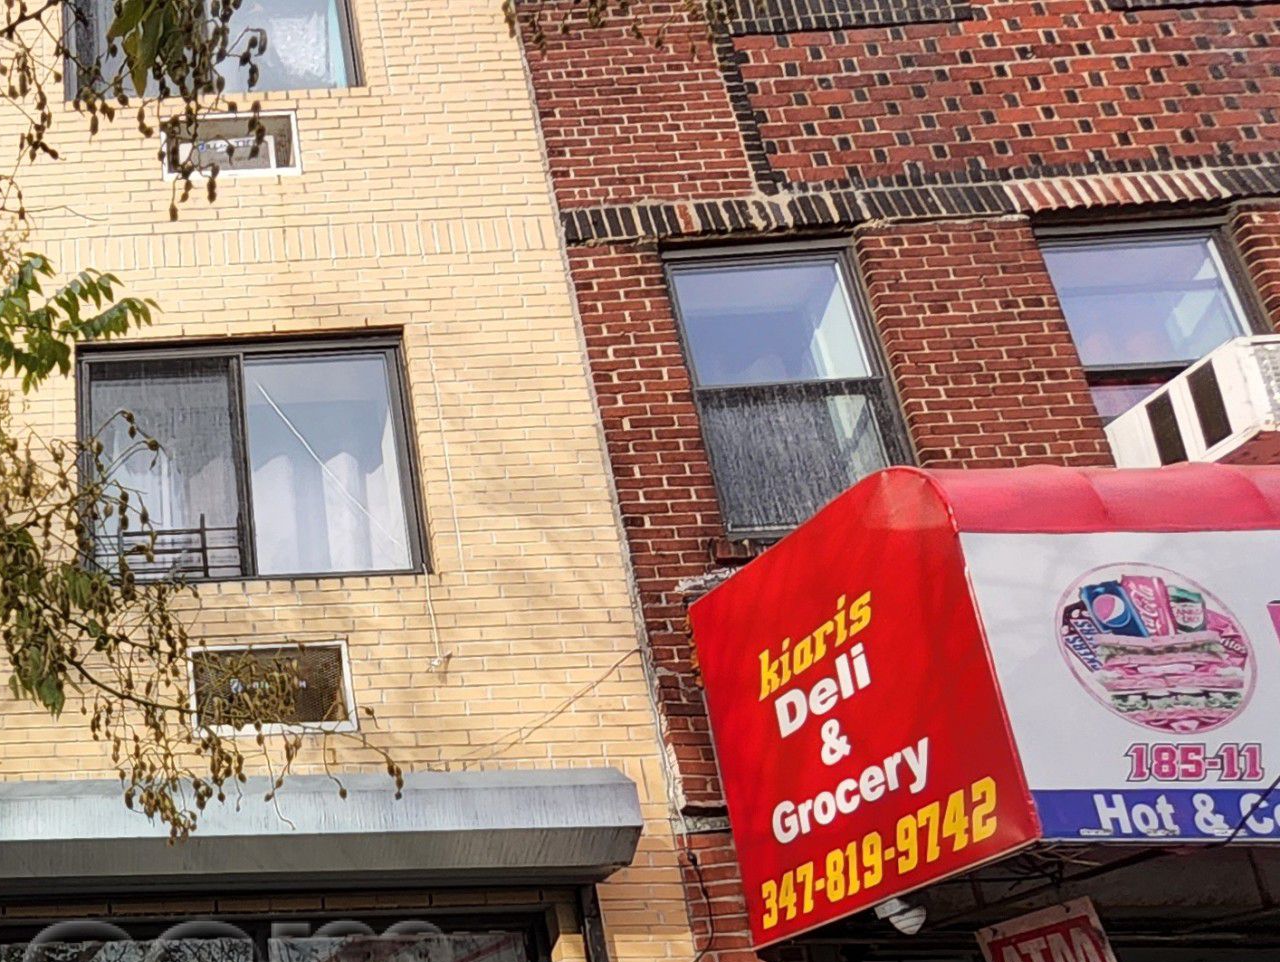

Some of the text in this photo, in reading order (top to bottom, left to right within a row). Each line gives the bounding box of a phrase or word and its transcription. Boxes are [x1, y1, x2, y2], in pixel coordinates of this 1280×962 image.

[758, 590, 871, 702] kiaris
[774, 642, 871, 739] Deli
[772, 737, 929, 844] Grocery
[820, 719, 851, 766] &
[1123, 742, 1265, 782] 185-11
[761, 776, 997, 930] 347-819-9742
[1093, 793, 1280, 835] Hot & C
